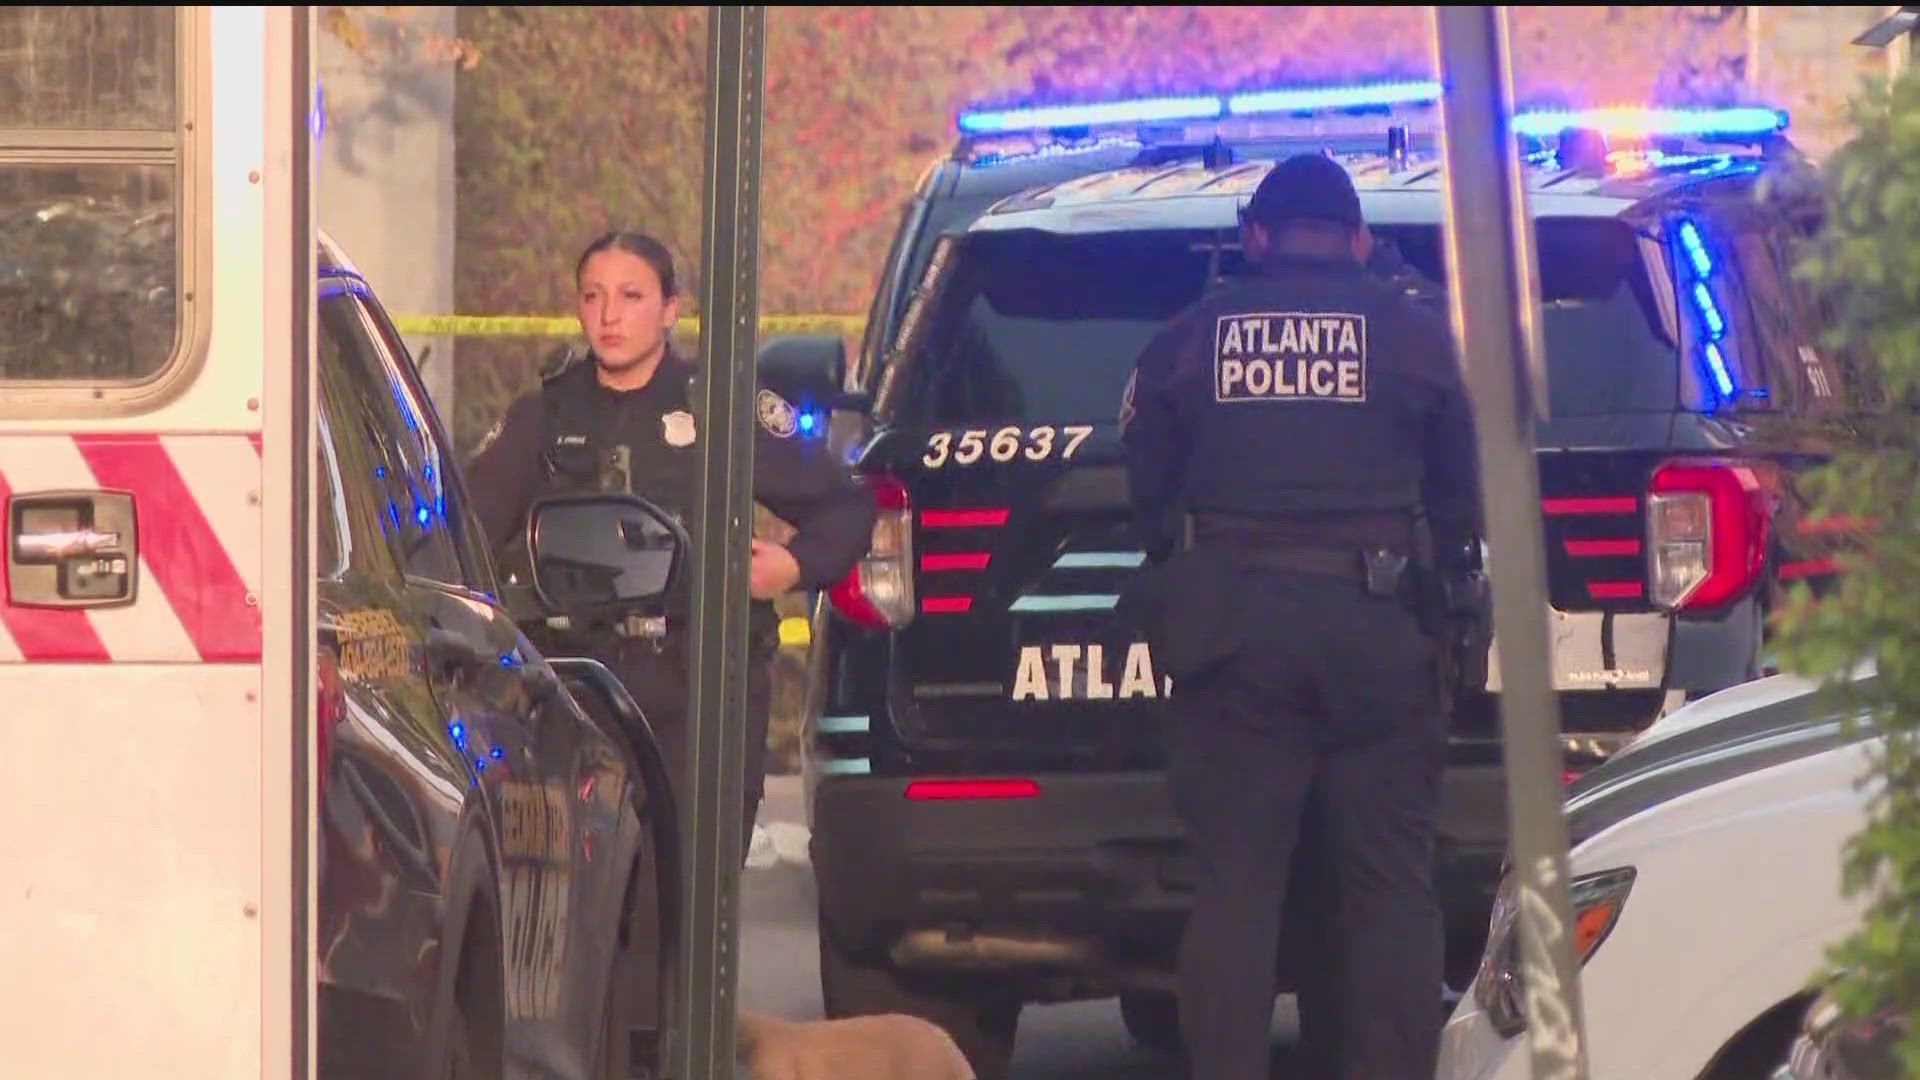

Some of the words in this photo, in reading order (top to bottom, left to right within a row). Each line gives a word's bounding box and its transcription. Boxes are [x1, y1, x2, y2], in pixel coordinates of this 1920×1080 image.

[1222, 319, 1358, 354] ATLANTA
[1222, 358, 1360, 395] POLICE
[922, 425, 1093, 468] 35637
[1012, 642, 1173, 701] ATLA
